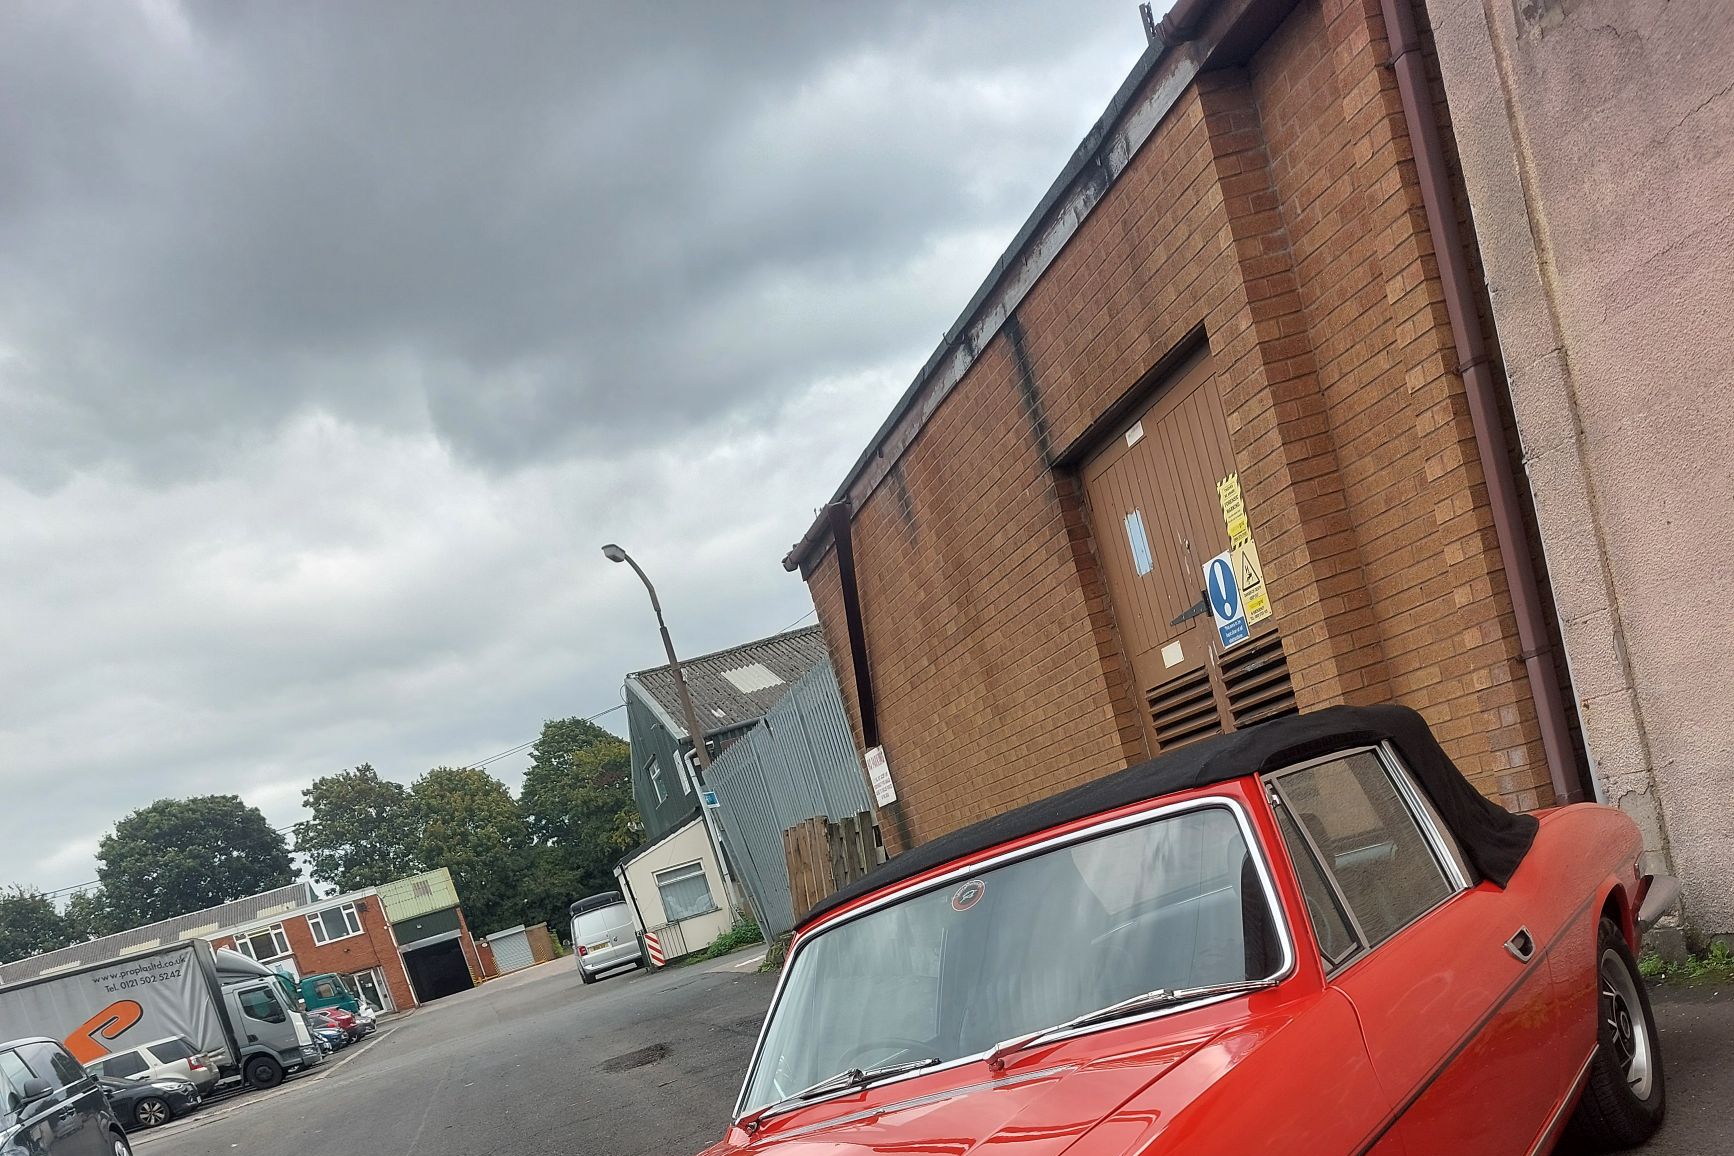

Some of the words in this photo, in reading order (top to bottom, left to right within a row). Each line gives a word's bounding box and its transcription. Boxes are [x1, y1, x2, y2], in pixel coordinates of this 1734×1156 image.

[120, 978, 139, 990] 0121
[140, 974, 157, 985] 502
[159, 969, 182, 982] 5242
